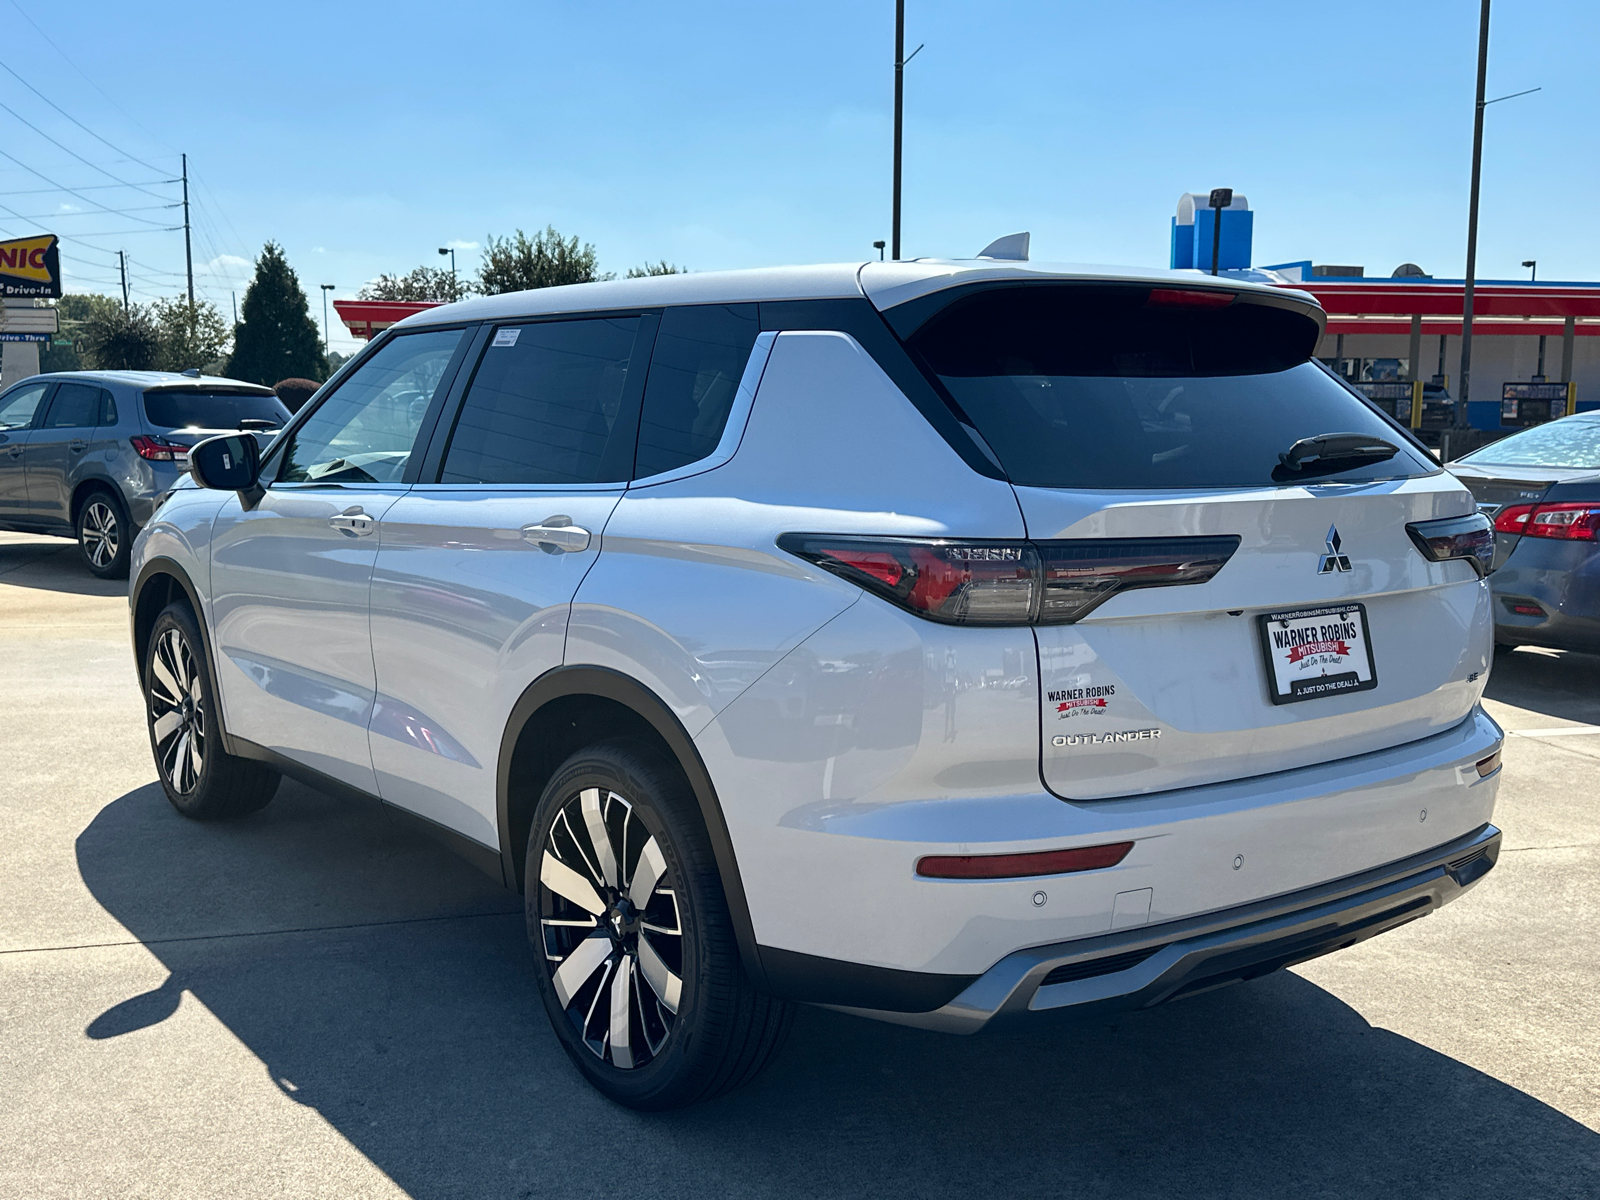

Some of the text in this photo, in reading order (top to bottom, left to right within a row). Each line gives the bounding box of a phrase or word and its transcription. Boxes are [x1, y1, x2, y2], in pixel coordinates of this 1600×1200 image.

[1273, 622, 1357, 649] WARNER ROBINS
[1298, 641, 1339, 656] MITSUBISHI
[1299, 654, 1343, 670] Just Do The Deal!
[1047, 684, 1115, 702] WARNER ROBINS
[1302, 680, 1353, 694] JUST DO THE DEAL!
[1066, 699, 1099, 708] MITSUBISHI
[1058, 712, 1071, 720] Just
[1052, 728, 1161, 747] OUTLANDER
